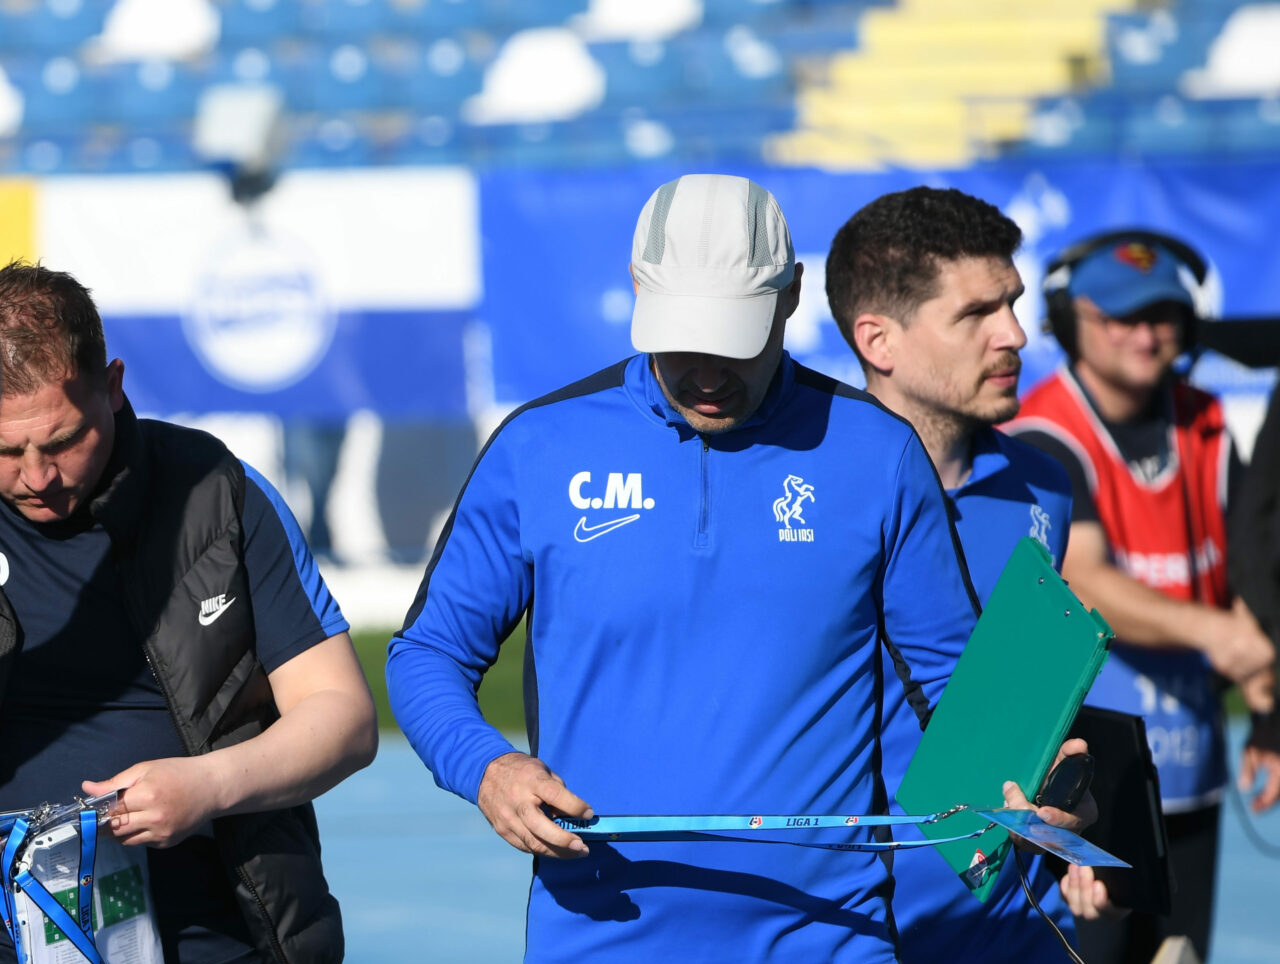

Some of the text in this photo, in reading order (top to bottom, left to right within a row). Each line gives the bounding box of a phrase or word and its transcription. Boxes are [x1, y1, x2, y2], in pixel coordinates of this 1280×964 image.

[569, 471, 655, 509] C.M.
[201, 593, 226, 615] NIKE
[786, 818, 820, 827] LIGA 1
